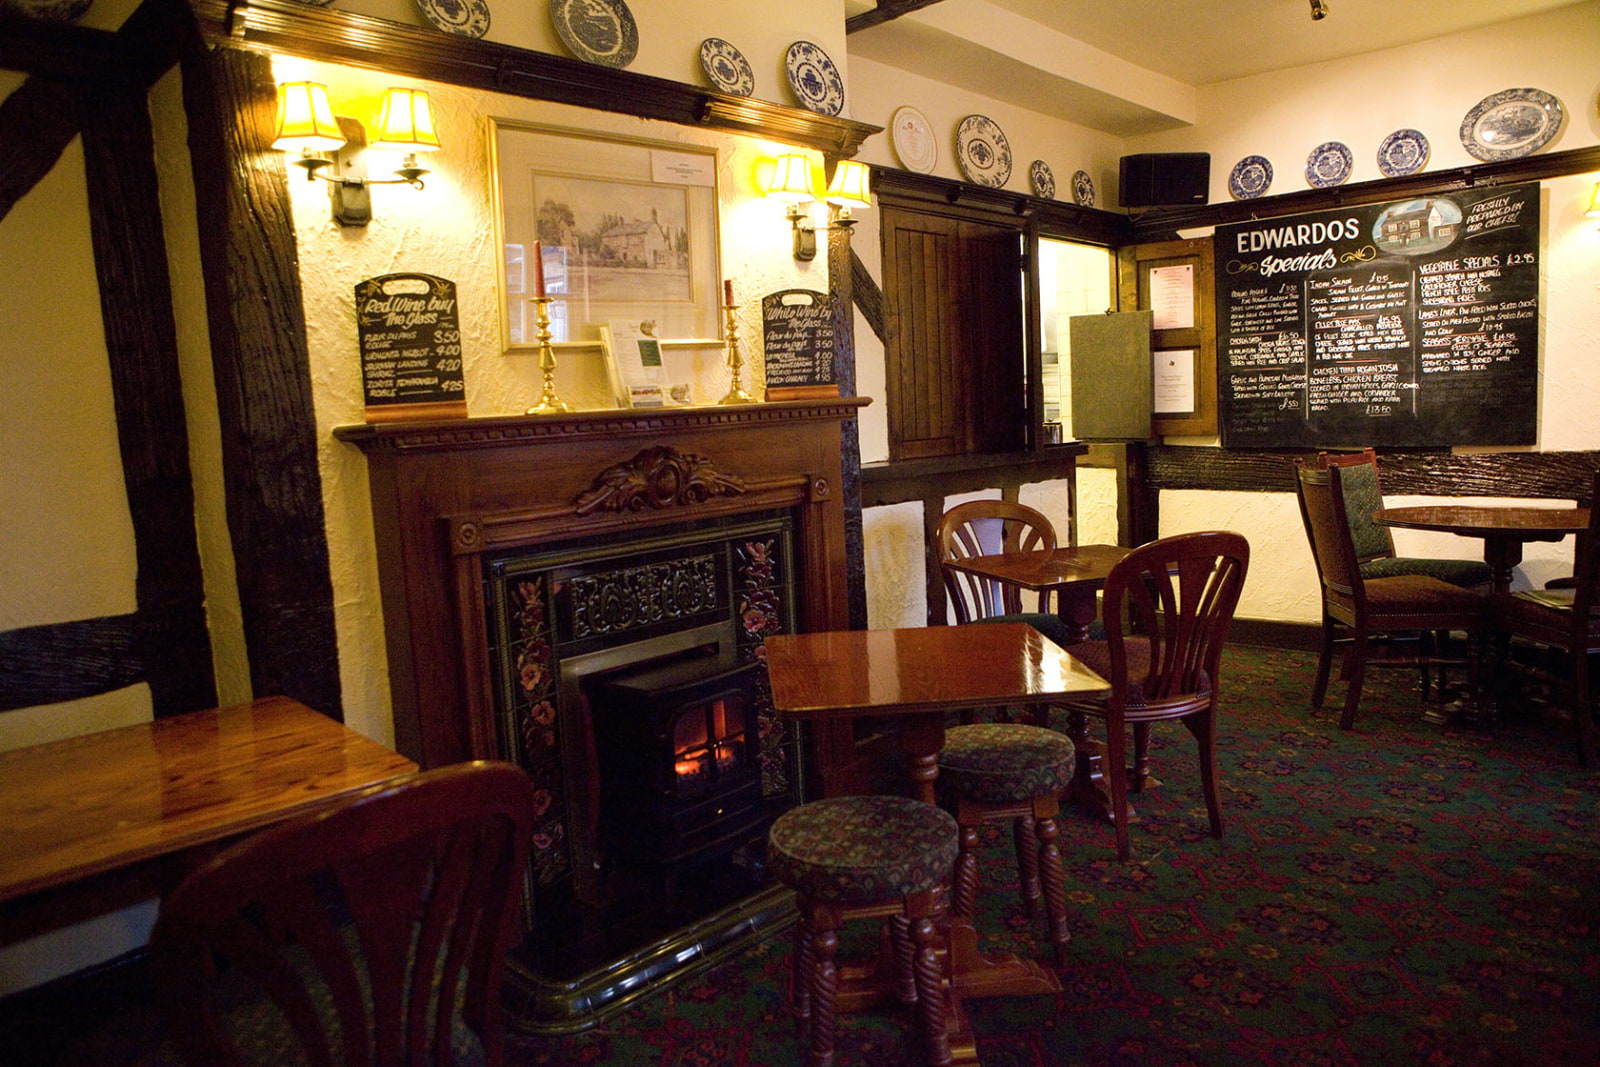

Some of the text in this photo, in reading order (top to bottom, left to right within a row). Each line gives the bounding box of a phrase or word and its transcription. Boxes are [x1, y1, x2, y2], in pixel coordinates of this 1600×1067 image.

[1466, 201, 1525, 225] PREPARED BY
[1472, 197, 1510, 214] FRESHLY
[1467, 223, 1483, 233] OUR
[1237, 218, 1359, 254] EDWARDOS
[1259, 248, 1338, 279] Specials
[1419, 253, 1535, 275] VEGETABLE SPECIALS £2.95
[1445, 273, 1466, 282] SPINACH
[1459, 279, 1483, 288] CHEESE
[1421, 289, 1442, 298] FRENCH
[365, 296, 455, 314] Red Wine buy
[768, 305, 833, 321] White Wine by
[383, 312, 438, 330] The Glass
[788, 318, 822, 332] The Glass
[434, 330, 460, 344] 3.50
[1313, 367, 1339, 376] CHICKEN
[1357, 365, 1377, 374] ROGAN
[1377, 364, 1399, 373] JOSH
[1310, 376, 1342, 385] BONELESS
[1343, 375, 1372, 383] CHICKEN
